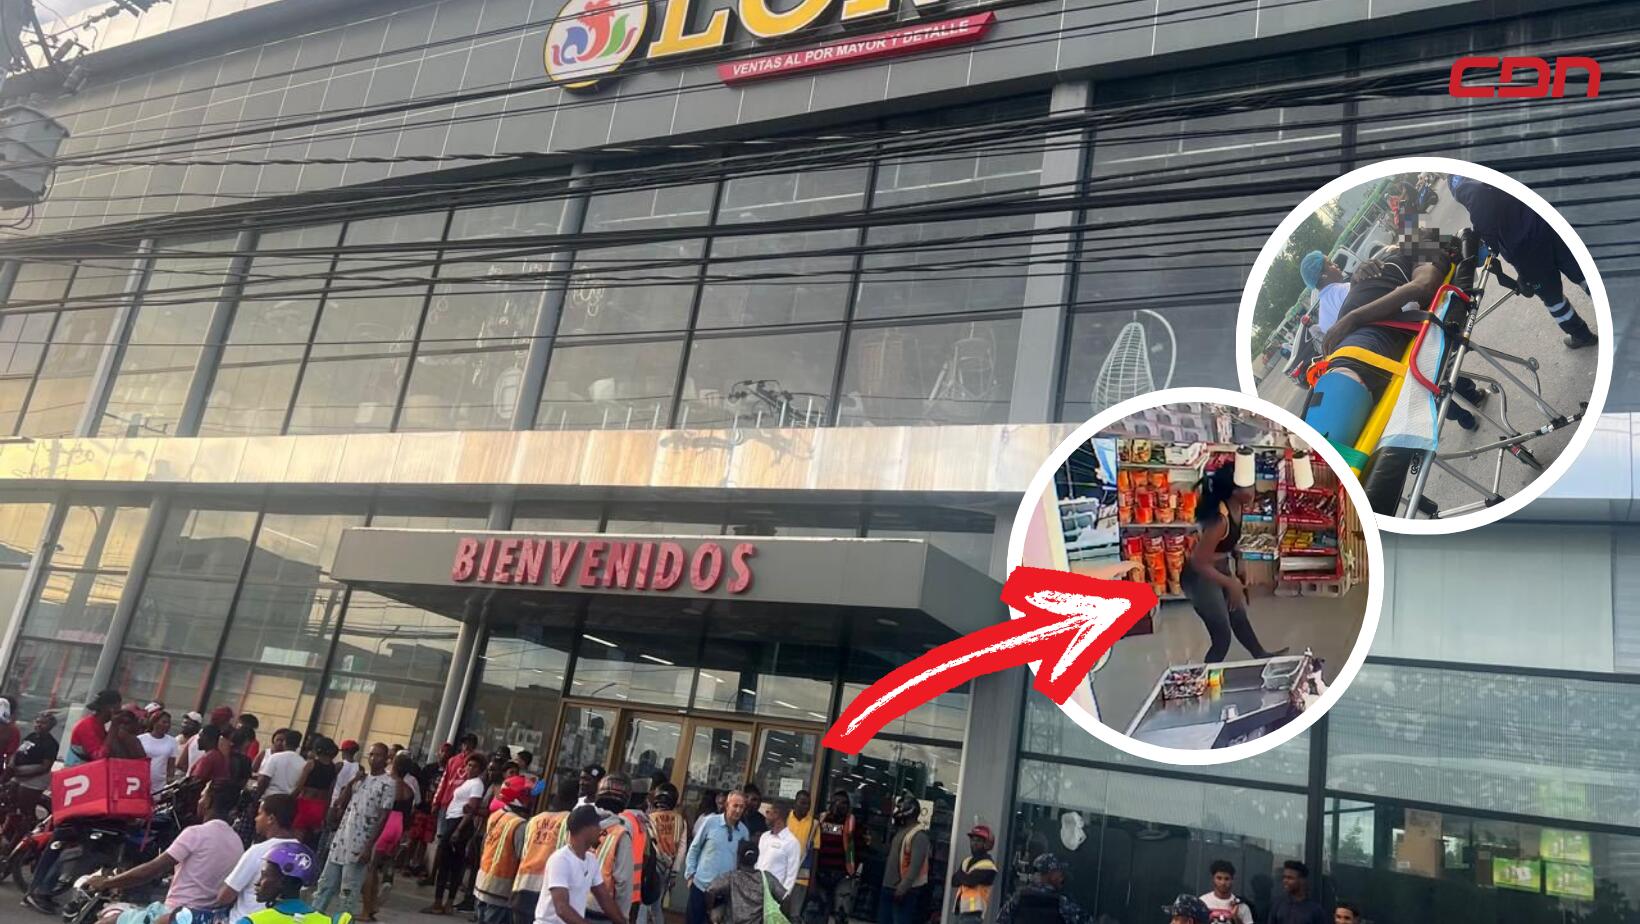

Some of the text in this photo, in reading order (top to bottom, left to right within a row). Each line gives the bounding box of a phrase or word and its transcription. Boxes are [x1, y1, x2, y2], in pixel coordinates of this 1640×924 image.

[733, 20, 970, 76] VENTAS AL POR MAYOR Y DETALLE
[452, 536, 757, 594] BIENVENIDOS
